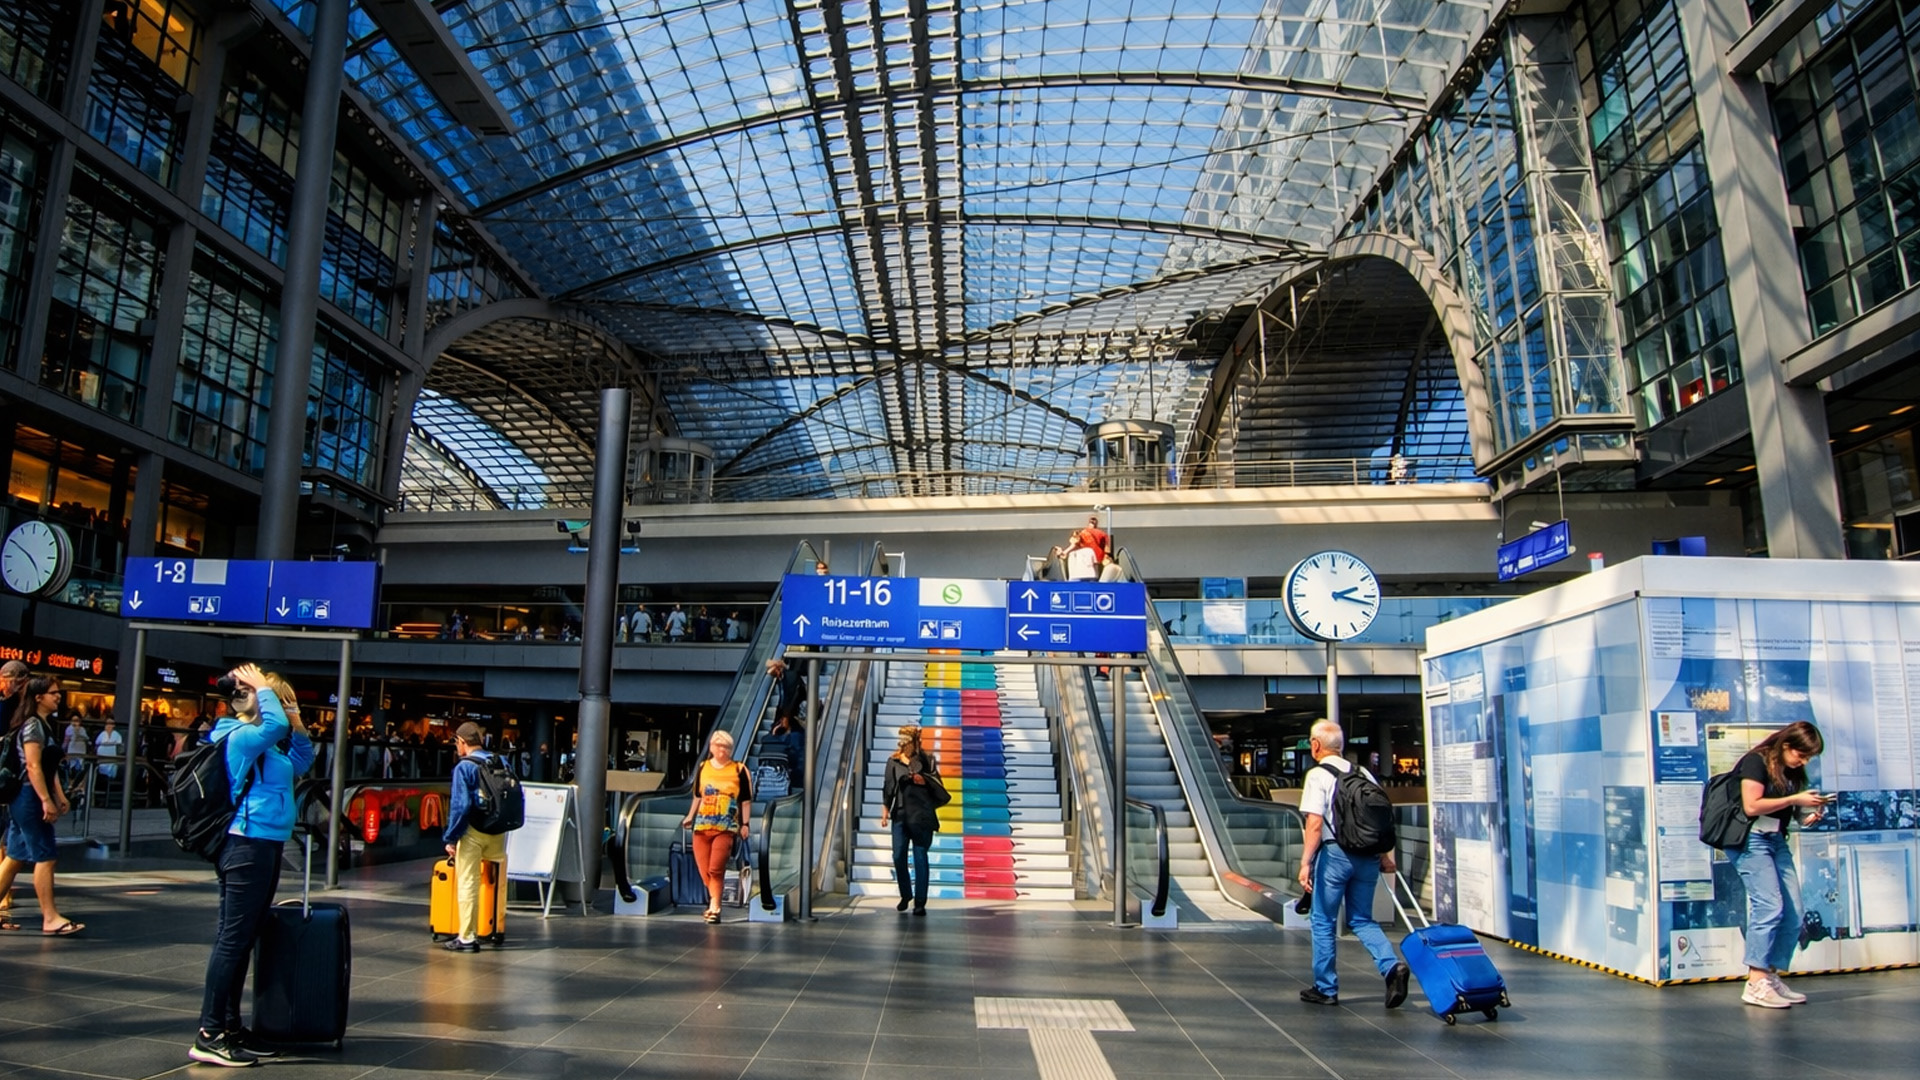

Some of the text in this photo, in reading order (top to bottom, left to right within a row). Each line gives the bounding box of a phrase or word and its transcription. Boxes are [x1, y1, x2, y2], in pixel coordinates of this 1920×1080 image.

[153, 560, 187, 583] 1-8
[823, 579, 892, 606] 11-16
[943, 584, 962, 604] S
